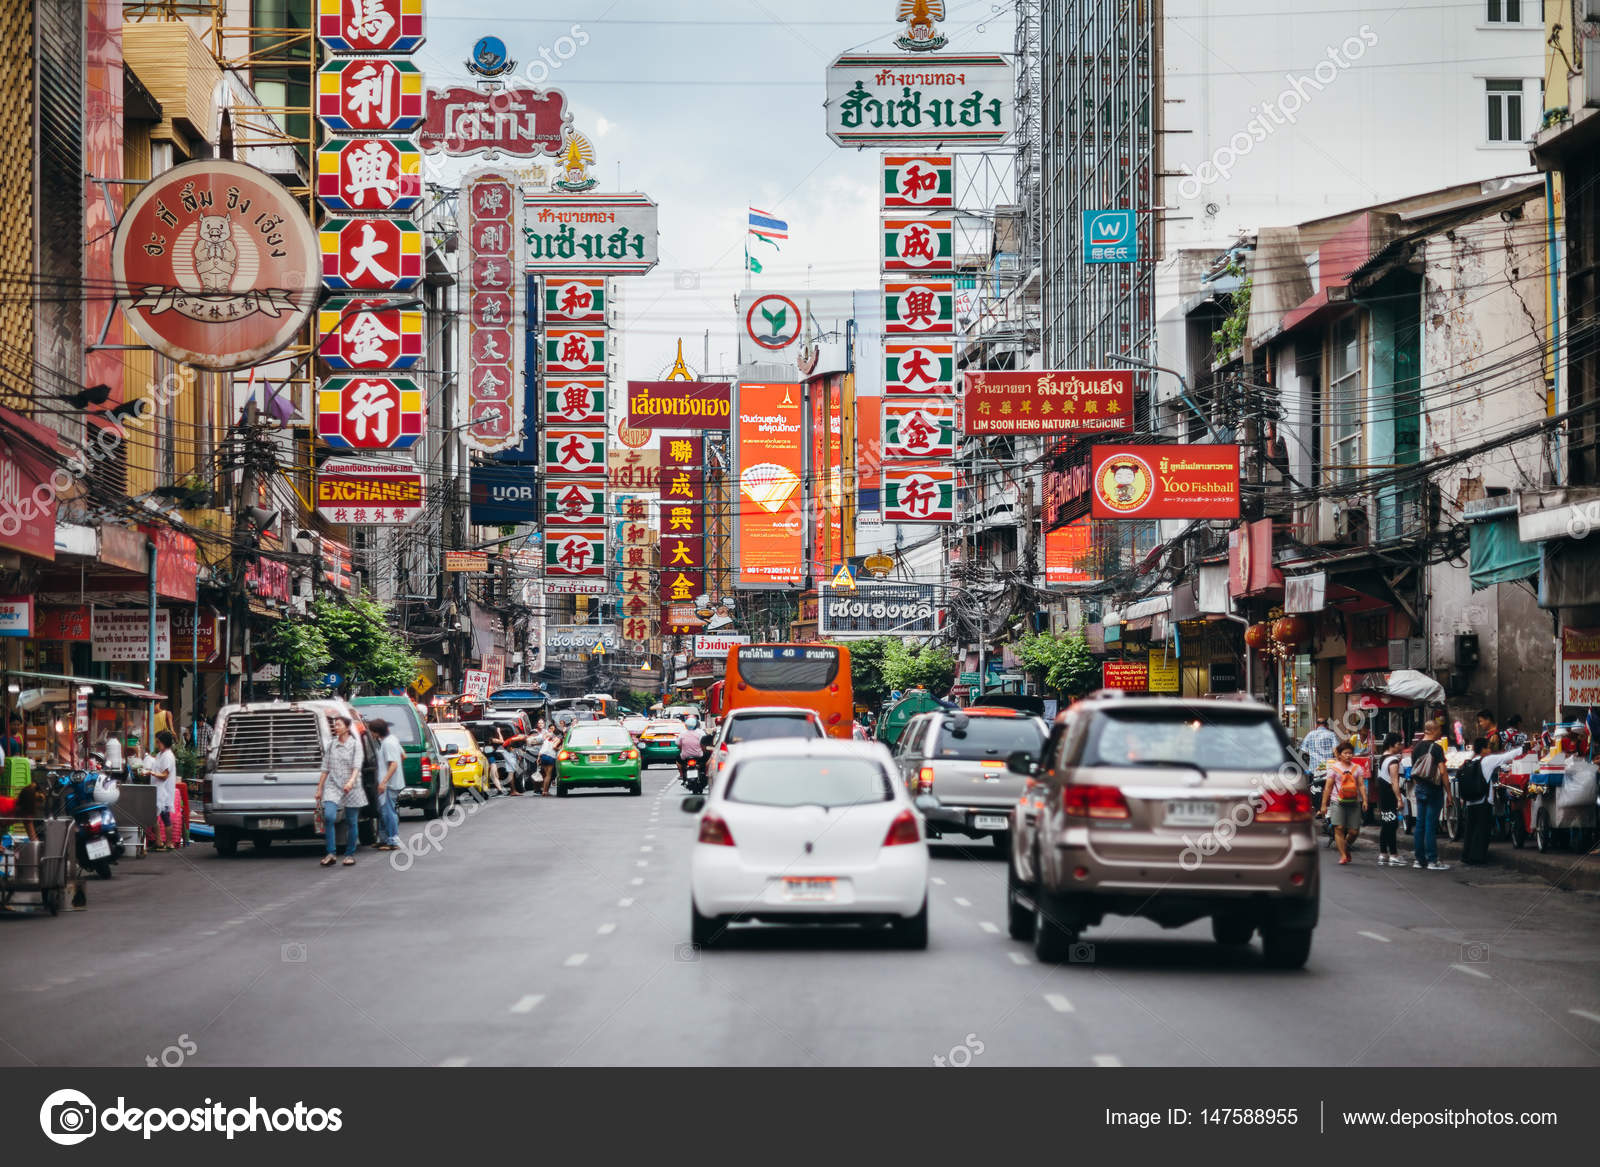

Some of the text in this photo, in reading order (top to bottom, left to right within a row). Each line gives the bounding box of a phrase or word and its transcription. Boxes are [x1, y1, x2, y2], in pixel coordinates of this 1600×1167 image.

[875, 70, 965, 86] ห้างขายทอง
[840, 80, 1002, 128] ฮั่วเซ่งเฮง
[445, 101, 536, 140] โต๊ะกัง
[536, 208, 615, 223] ห้างขายทอง
[1098, 222, 1120, 236] W
[900, 165, 939, 515] 和成興大金行
[974, 381, 1032, 394] ร้านขายยา
[631, 389, 730, 416] เลี่ยงเซ่งเฮง
[558, 285, 594, 570] 和成興大金行
[973, 418, 1126, 430] LIM SOON HENG NATURAL MEDICINE
[319, 481, 420, 501] EXCHANGE
[493, 486, 532, 501] UOB
[1191, 482, 1234, 493] Fishball
[782, 649, 795, 657] 40
